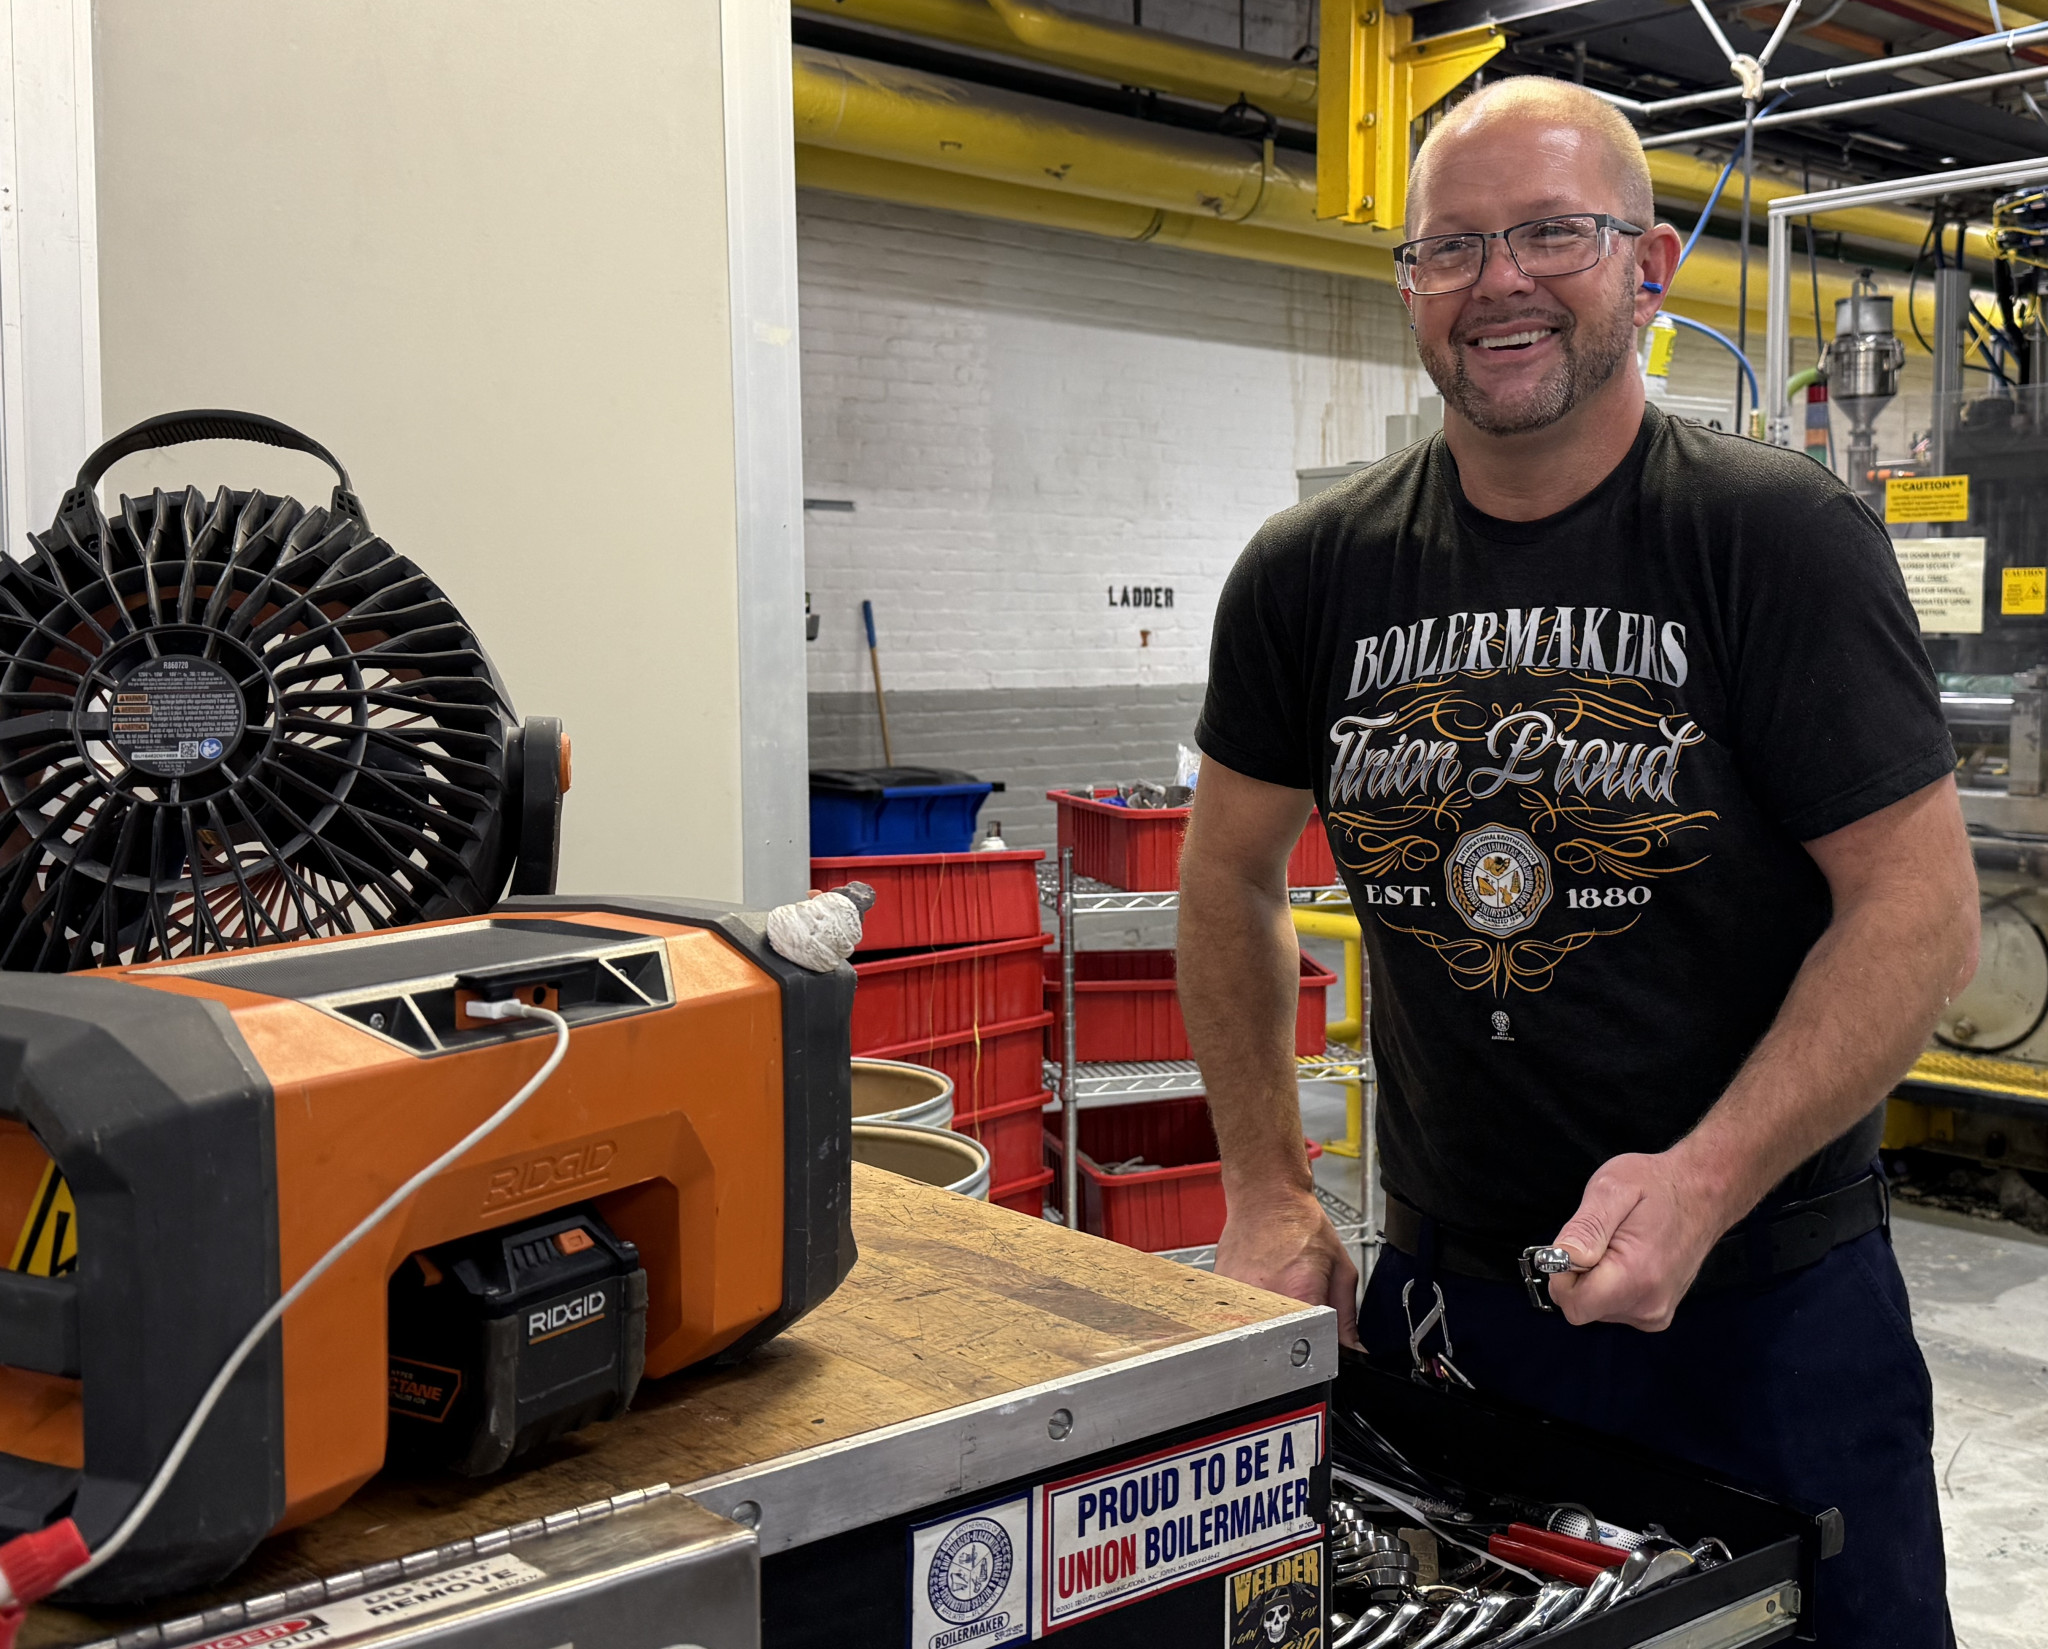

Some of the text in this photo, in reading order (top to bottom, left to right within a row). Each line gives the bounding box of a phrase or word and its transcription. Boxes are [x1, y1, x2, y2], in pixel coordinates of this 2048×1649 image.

[1108, 585, 1174, 608] LADDER
[1345, 606, 1689, 700] BOILERMAKERS
[1328, 711, 1706, 809] Union Proud
[1364, 884, 1652, 910] EST. 1880
[485, 1140, 618, 1206] RIDGID
[528, 1290, 606, 1337] RIDGID
[388, 1377, 443, 1402] CTANE
[1077, 1432, 1295, 1538] PROUD TO BE A
[1058, 1477, 1310, 1599] UNION BOILERMAKER
[367, 1568, 518, 1617] REMOVE
[421, 1563, 490, 1588] NOT
[1233, 1549, 1319, 1614] WELDER
[935, 1615, 1004, 1649] BOILERMAKER
